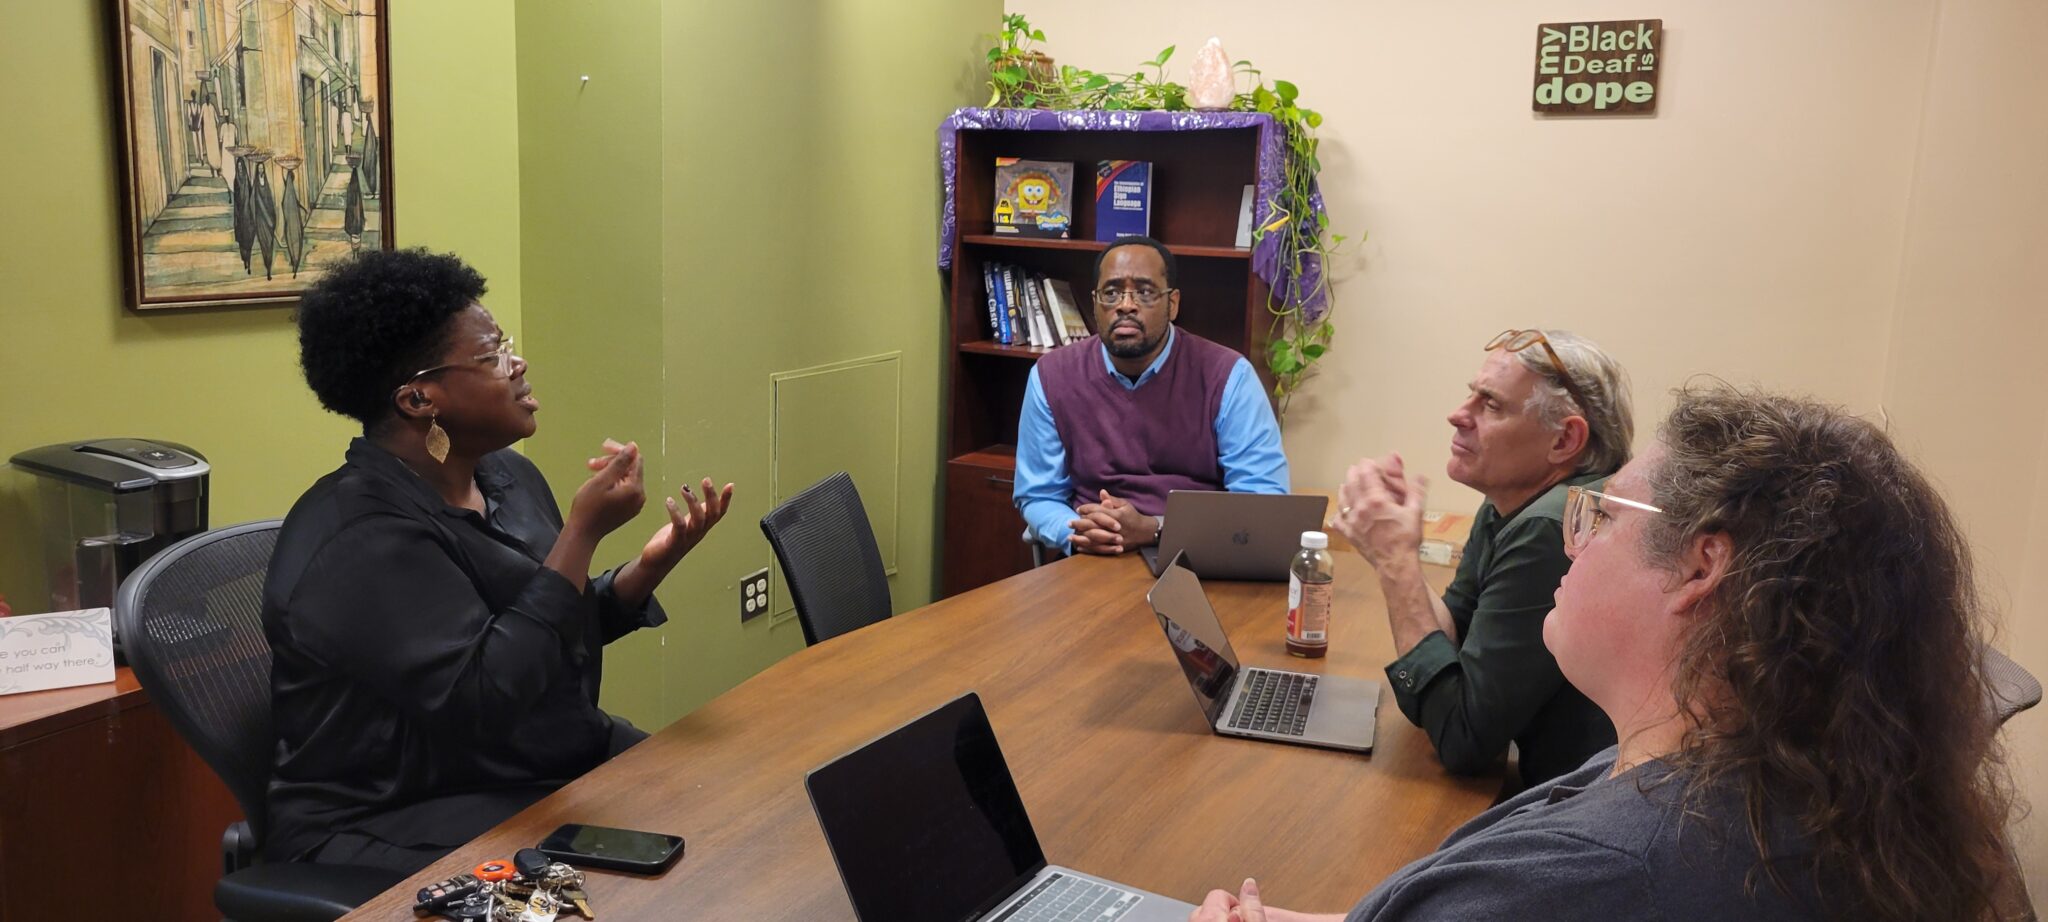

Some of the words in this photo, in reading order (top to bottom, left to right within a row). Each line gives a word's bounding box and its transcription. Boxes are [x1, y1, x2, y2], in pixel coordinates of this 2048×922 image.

[1568, 23, 1654, 52] Black
[1540, 27, 1566, 74] my
[1563, 53, 1637, 74] Deaf
[1637, 53, 1654, 71] is
[1535, 77, 1654, 109] dope
[1113, 199, 1142, 208] Language
[988, 298, 998, 328] Caste
[14, 648, 37, 658] you
[41, 645, 65, 655] can
[6, 663, 29, 674] half
[33, 662, 60, 671] way
